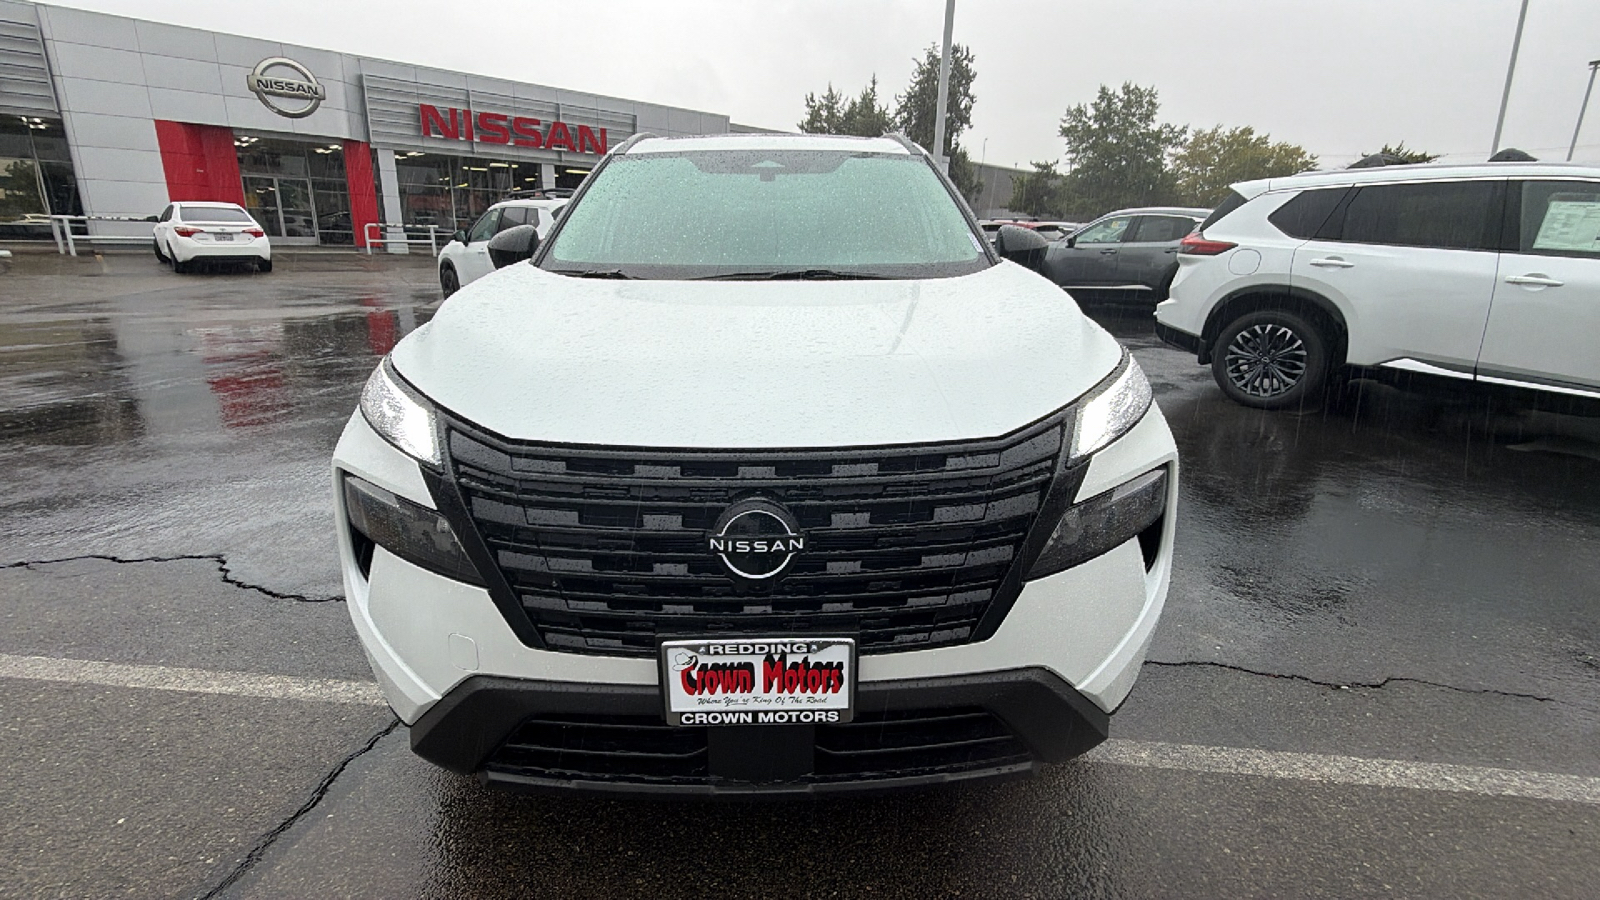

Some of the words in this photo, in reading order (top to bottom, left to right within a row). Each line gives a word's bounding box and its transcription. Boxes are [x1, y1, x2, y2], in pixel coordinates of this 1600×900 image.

[256, 79, 319, 95] NISSAN
[419, 103, 607, 155] NISSAN
[709, 537, 804, 553] NISSAN
[709, 643, 808, 655] REDDING
[681, 657, 755, 696] Crown
[763, 654, 844, 696] Motors
[697, 697, 722, 705] Where
[752, 696, 772, 705] King
[775, 696, 786, 705] Of
[788, 696, 803, 704] The
[806, 696, 828, 704] Road
[681, 712, 753, 724] CROWN
[758, 711, 839, 723] MOTORS
